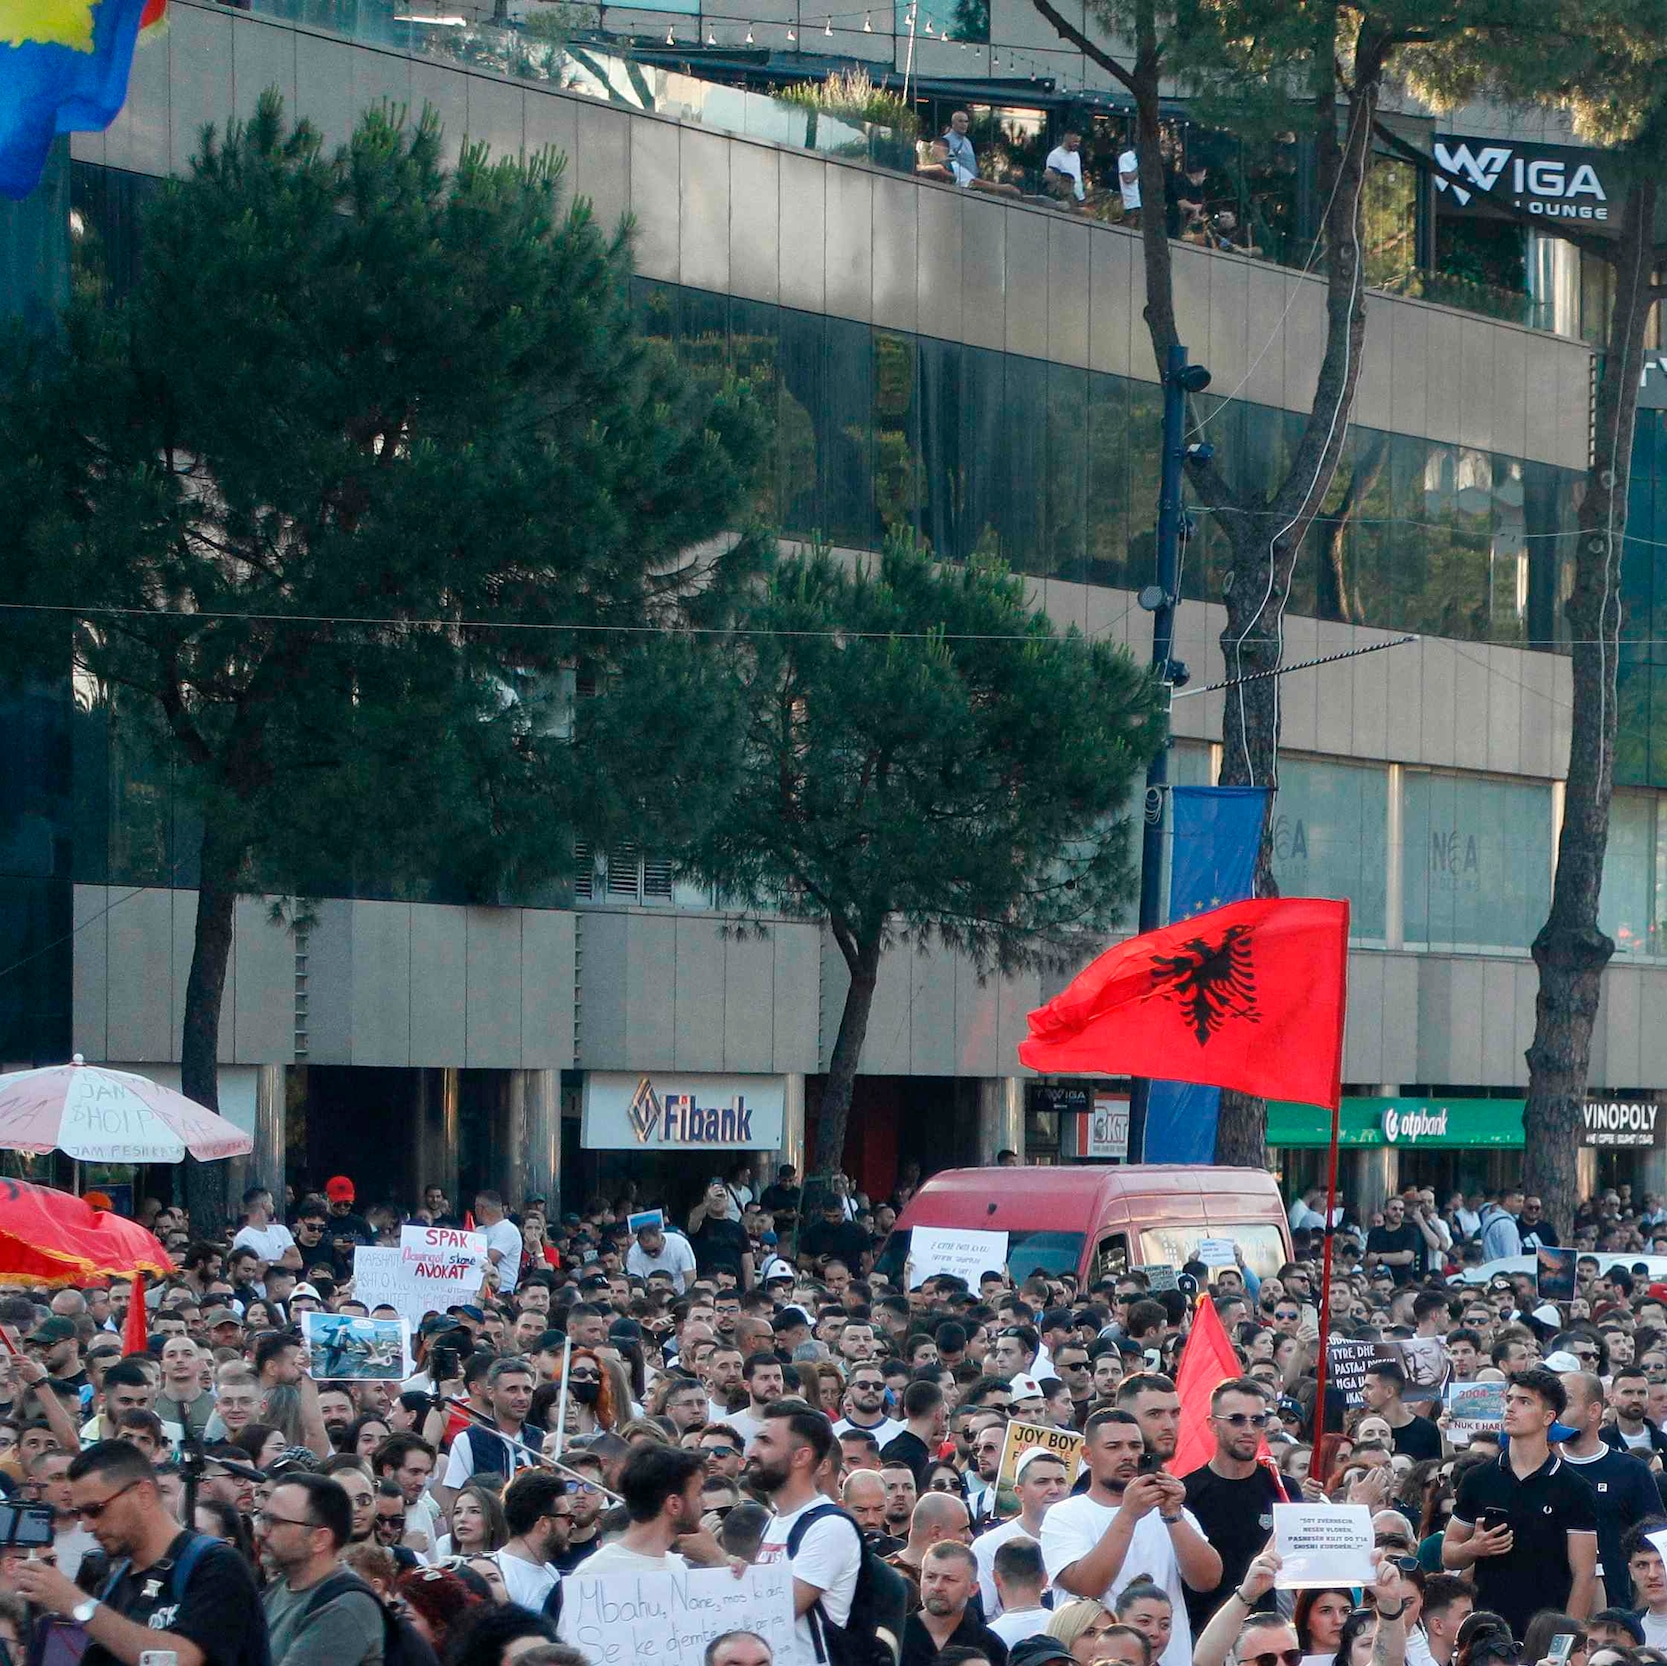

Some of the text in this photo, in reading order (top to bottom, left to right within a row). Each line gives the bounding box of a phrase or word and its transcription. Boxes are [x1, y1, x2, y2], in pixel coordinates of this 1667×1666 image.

[661, 1094, 752, 1142] Fibank
[1401, 1108, 1448, 1143] otpbank
[1583, 1103, 1658, 1130] VINOPOLY
[426, 1229, 469, 1248] SPAK
[415, 1262, 470, 1280] AVOKAT
[1357, 1344, 1375, 1358] DHE
[1334, 1360, 1366, 1376] PASTAJ
[1454, 1420, 1474, 1430] NUK
[1014, 1426, 1079, 1452] JOY BOY
[577, 1626, 622, 1666] Se
[632, 1626, 657, 1657] ke
